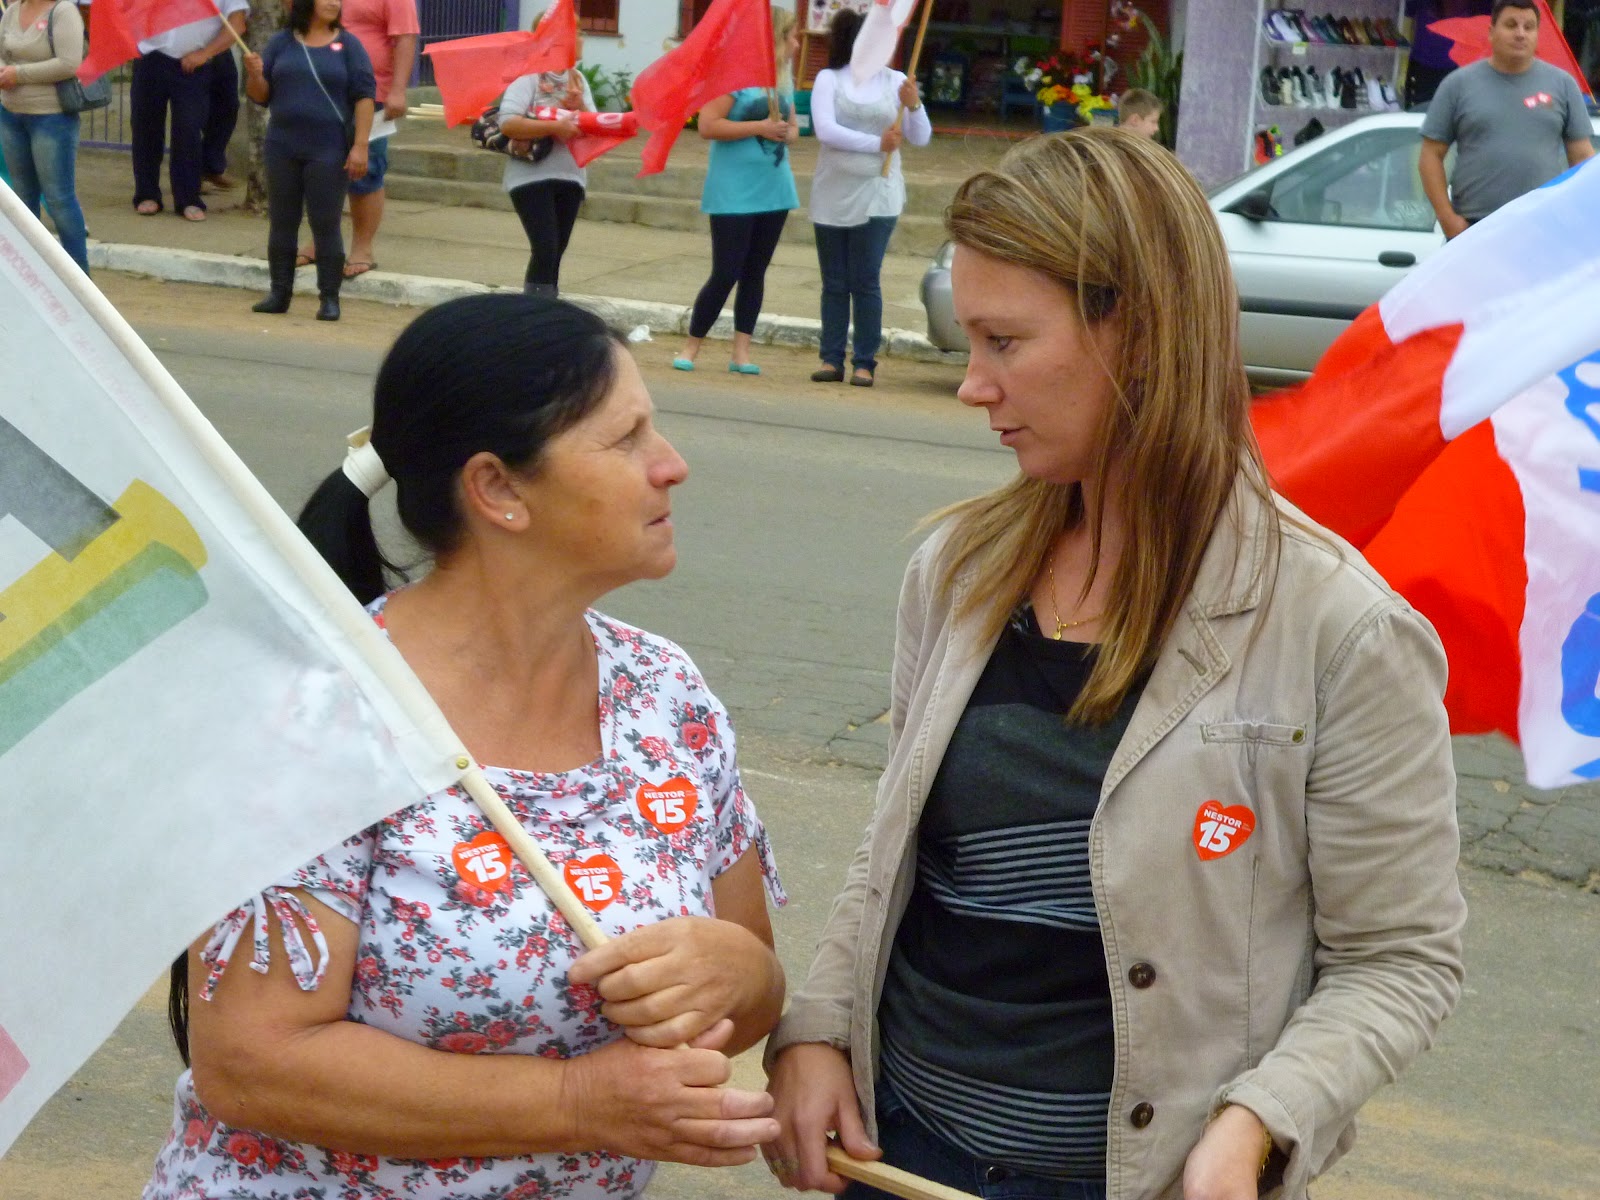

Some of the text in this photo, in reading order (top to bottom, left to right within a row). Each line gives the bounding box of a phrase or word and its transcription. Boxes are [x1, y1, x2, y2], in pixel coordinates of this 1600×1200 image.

[643, 790, 686, 799] NESTOR
[648, 799, 686, 824] 15
[1203, 808, 1243, 829] NESTOR
[1198, 820, 1238, 853] 15
[458, 843, 499, 860] NESTOR
[466, 851, 507, 883] 15
[569, 867, 609, 876] NESTOR
[573, 875, 613, 902] 15
